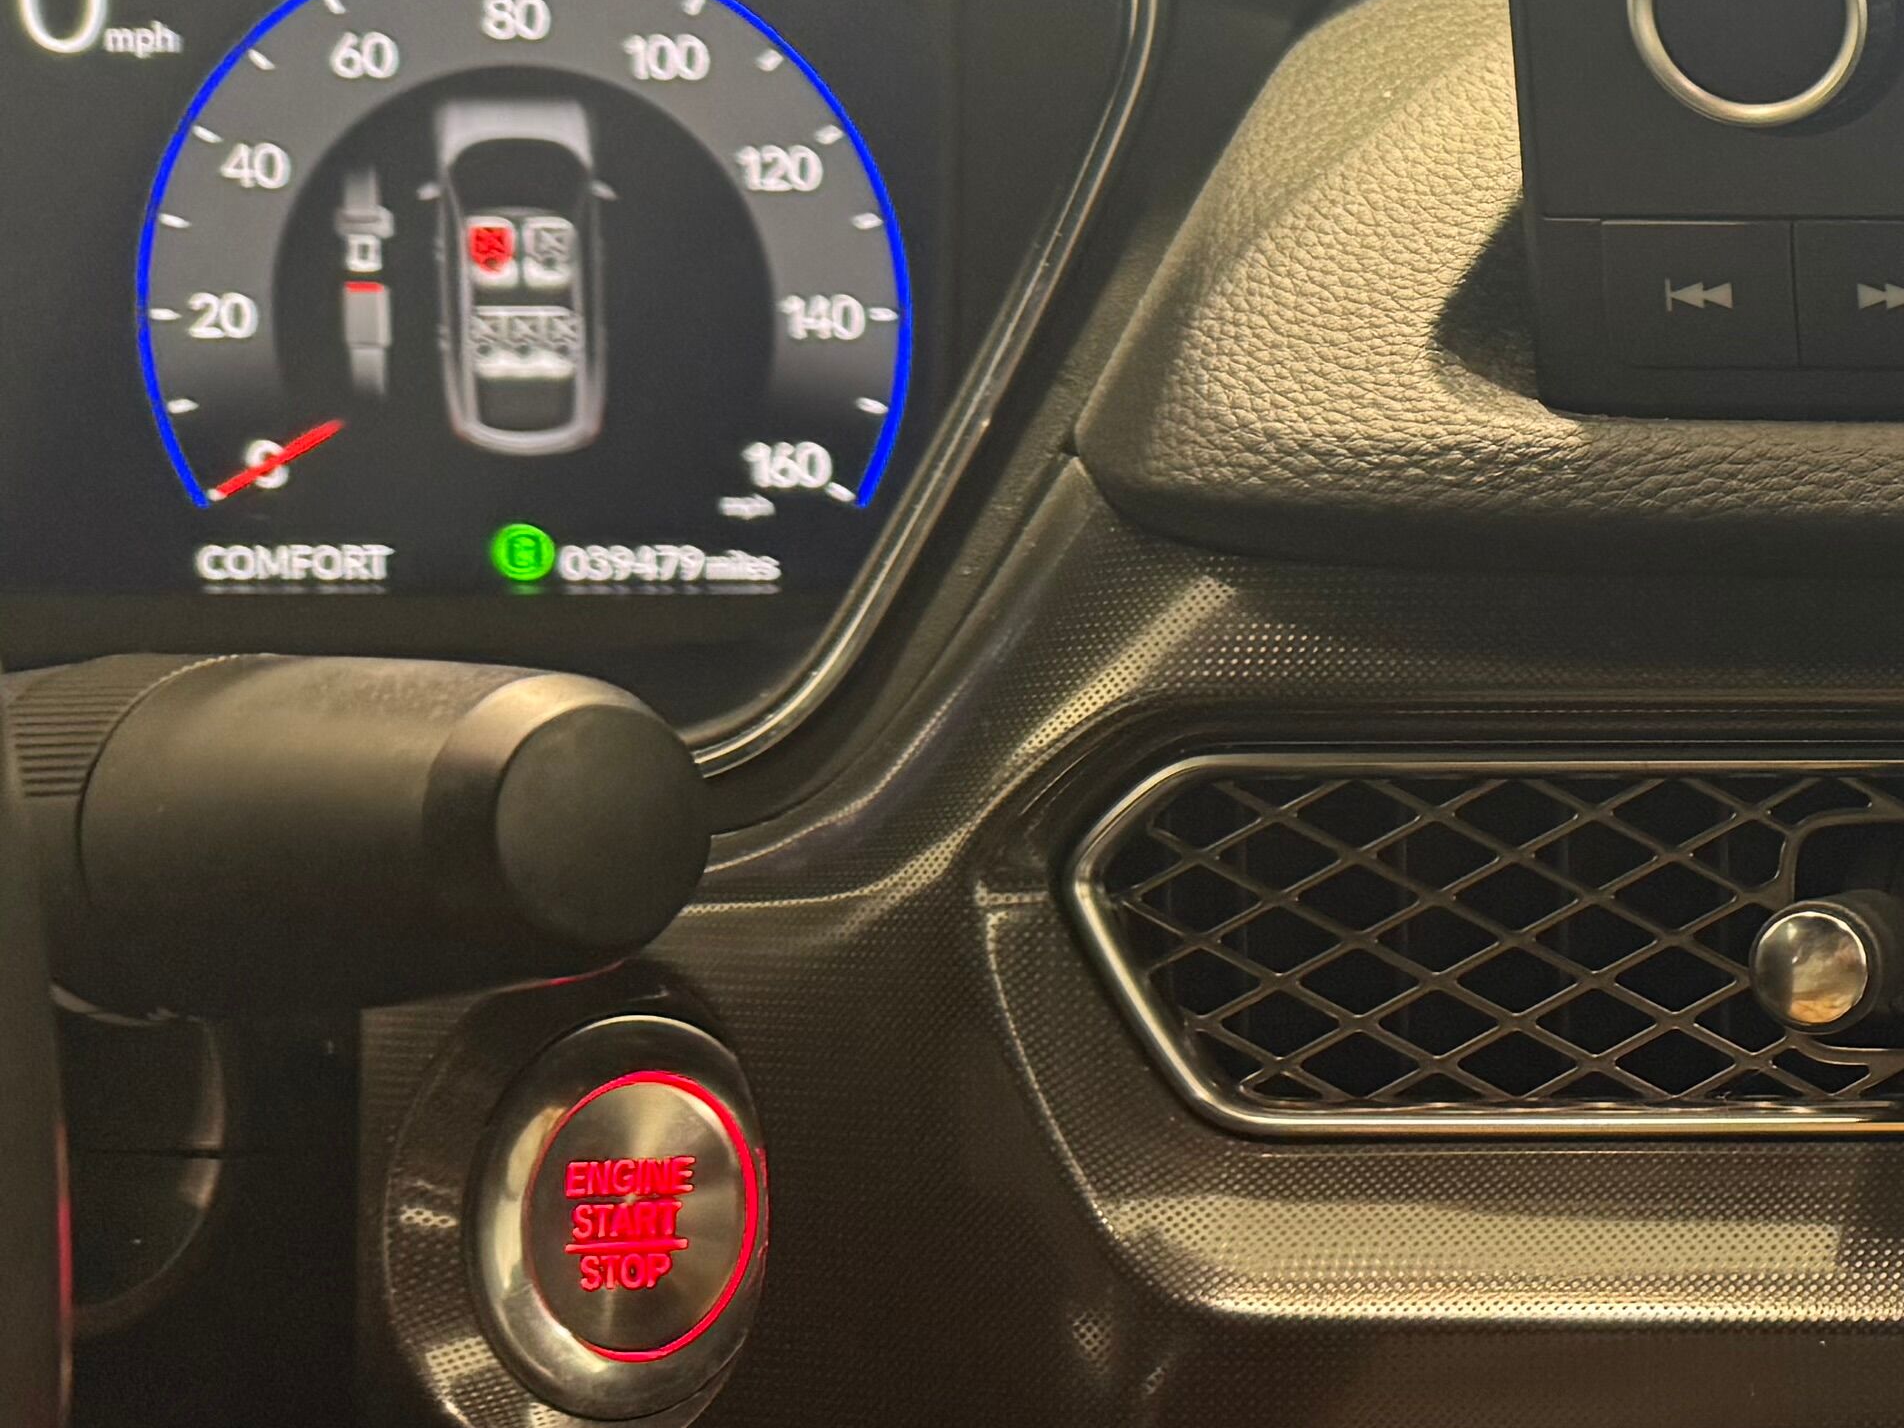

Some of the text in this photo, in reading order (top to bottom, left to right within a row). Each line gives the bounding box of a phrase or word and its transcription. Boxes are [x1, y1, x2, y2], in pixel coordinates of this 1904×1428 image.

[105, 23, 181, 58] mph
[330, 33, 398, 80] 60
[623, 36, 710, 81] 100
[221, 144, 290, 189] 40
[738, 147, 823, 192] 120
[188, 294, 258, 340] 20
[781, 295, 865, 341] 140
[742, 441, 832, 488] 160
[195, 544, 396, 581] COMFORT
[564, 1156, 696, 1199] ENGINE
[572, 1199, 682, 1241] START
[580, 1254, 672, 1291] STOP
